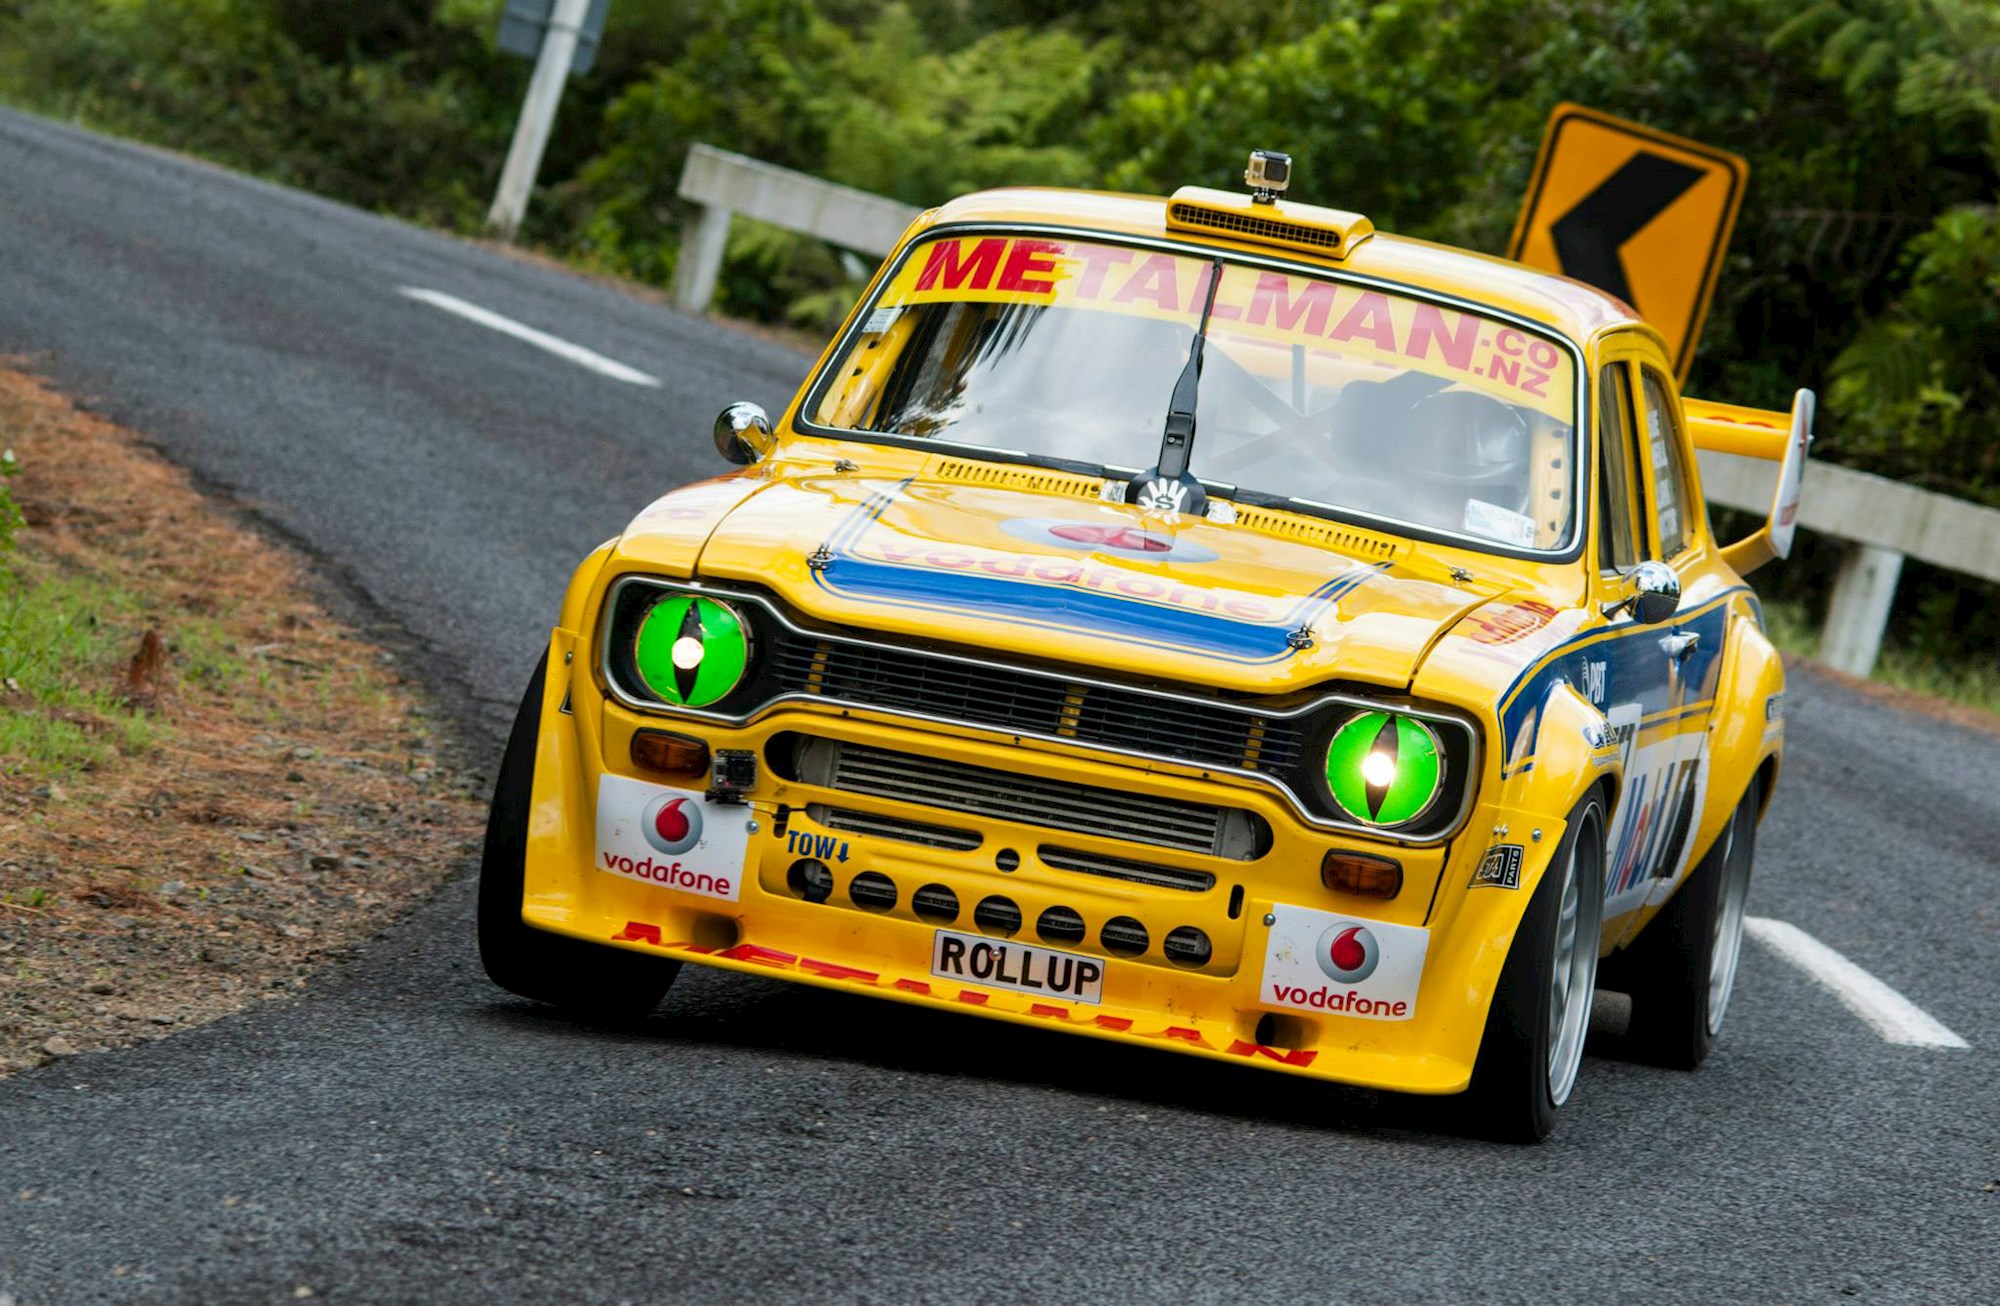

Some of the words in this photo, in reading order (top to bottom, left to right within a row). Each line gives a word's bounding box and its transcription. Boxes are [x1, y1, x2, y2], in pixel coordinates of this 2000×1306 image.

[915, 238, 1481, 371] METALMAN
[878, 543, 1269, 620] vodafone
[787, 830, 837, 861] TOW
[1506, 850, 1520, 884] PARTS
[603, 850, 730, 895] vodafone
[941, 937, 1101, 996] ROLLUP
[1273, 983, 1407, 1017] vodafone
